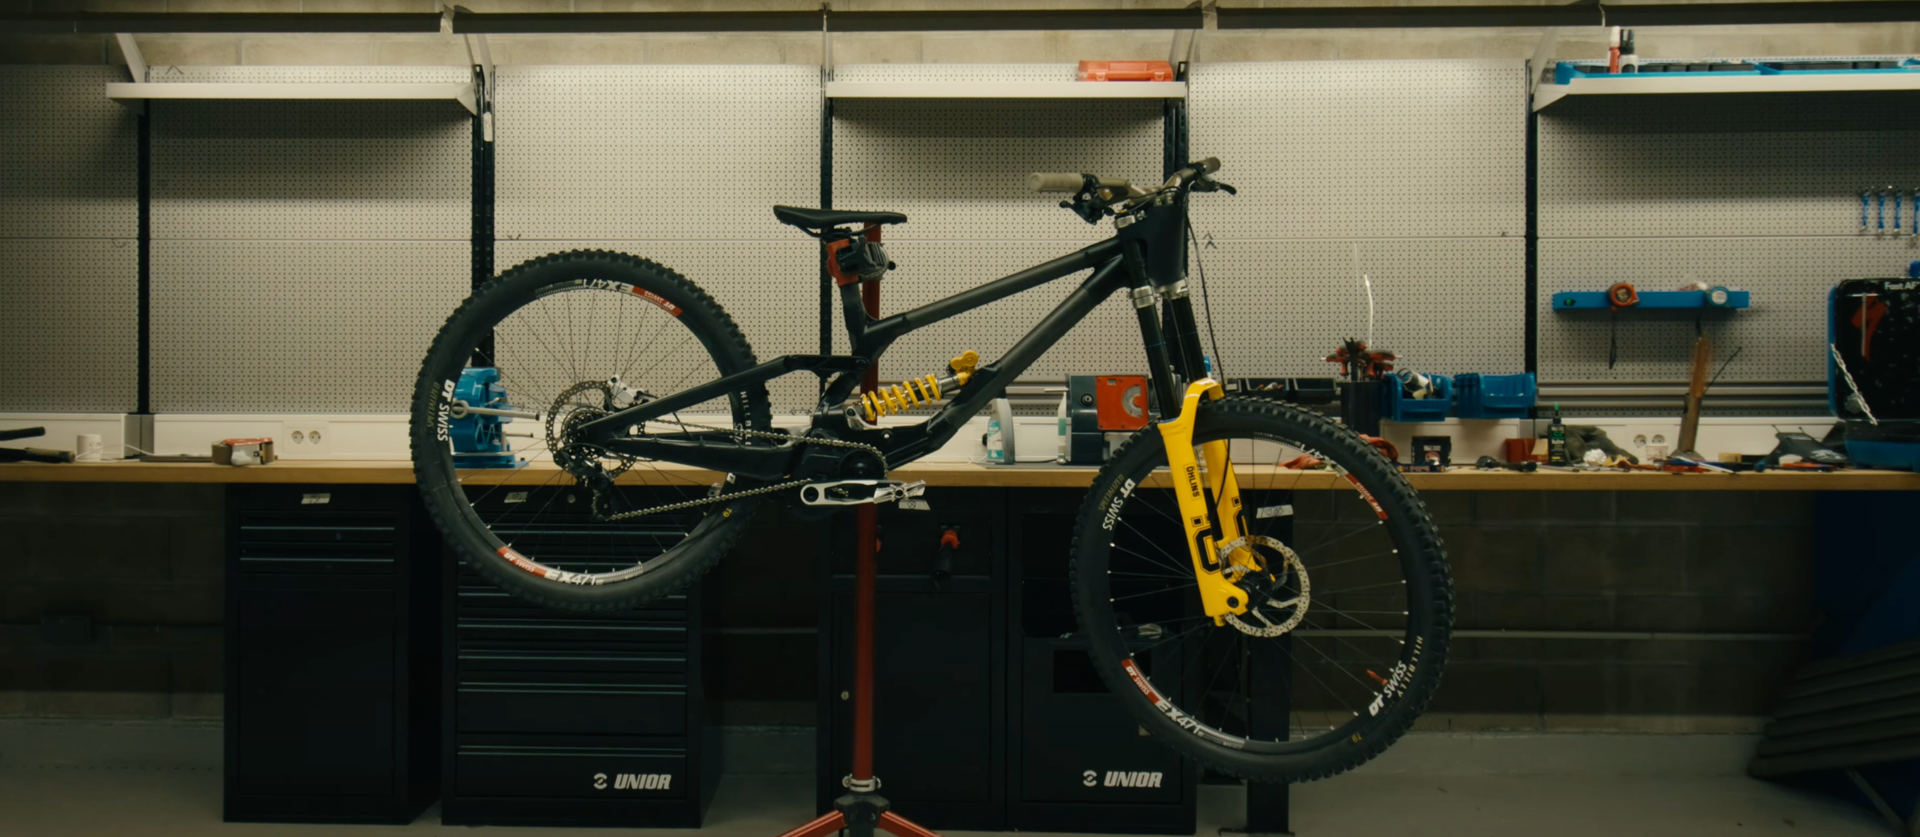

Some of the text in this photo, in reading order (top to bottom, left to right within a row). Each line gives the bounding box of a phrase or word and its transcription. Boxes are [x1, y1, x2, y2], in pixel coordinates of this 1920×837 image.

[1884, 281, 1904, 290] Fast
[643, 290, 676, 311] DT SWISS
[437, 378, 456, 442] DT SWISS
[1102, 477, 1137, 531] DT SWISS
[503, 552, 535, 573] DT SWISS
[544, 569, 597, 586] EX471
[1396, 635, 1424, 699] HILLBILLY
[1125, 665, 1151, 695] DT SWISS
[1368, 660, 1408, 717] DT SWISS
[1155, 700, 1202, 735] EX471
[613, 773, 672, 790] UNIOR
[1103, 771, 1163, 788] UNIOR
